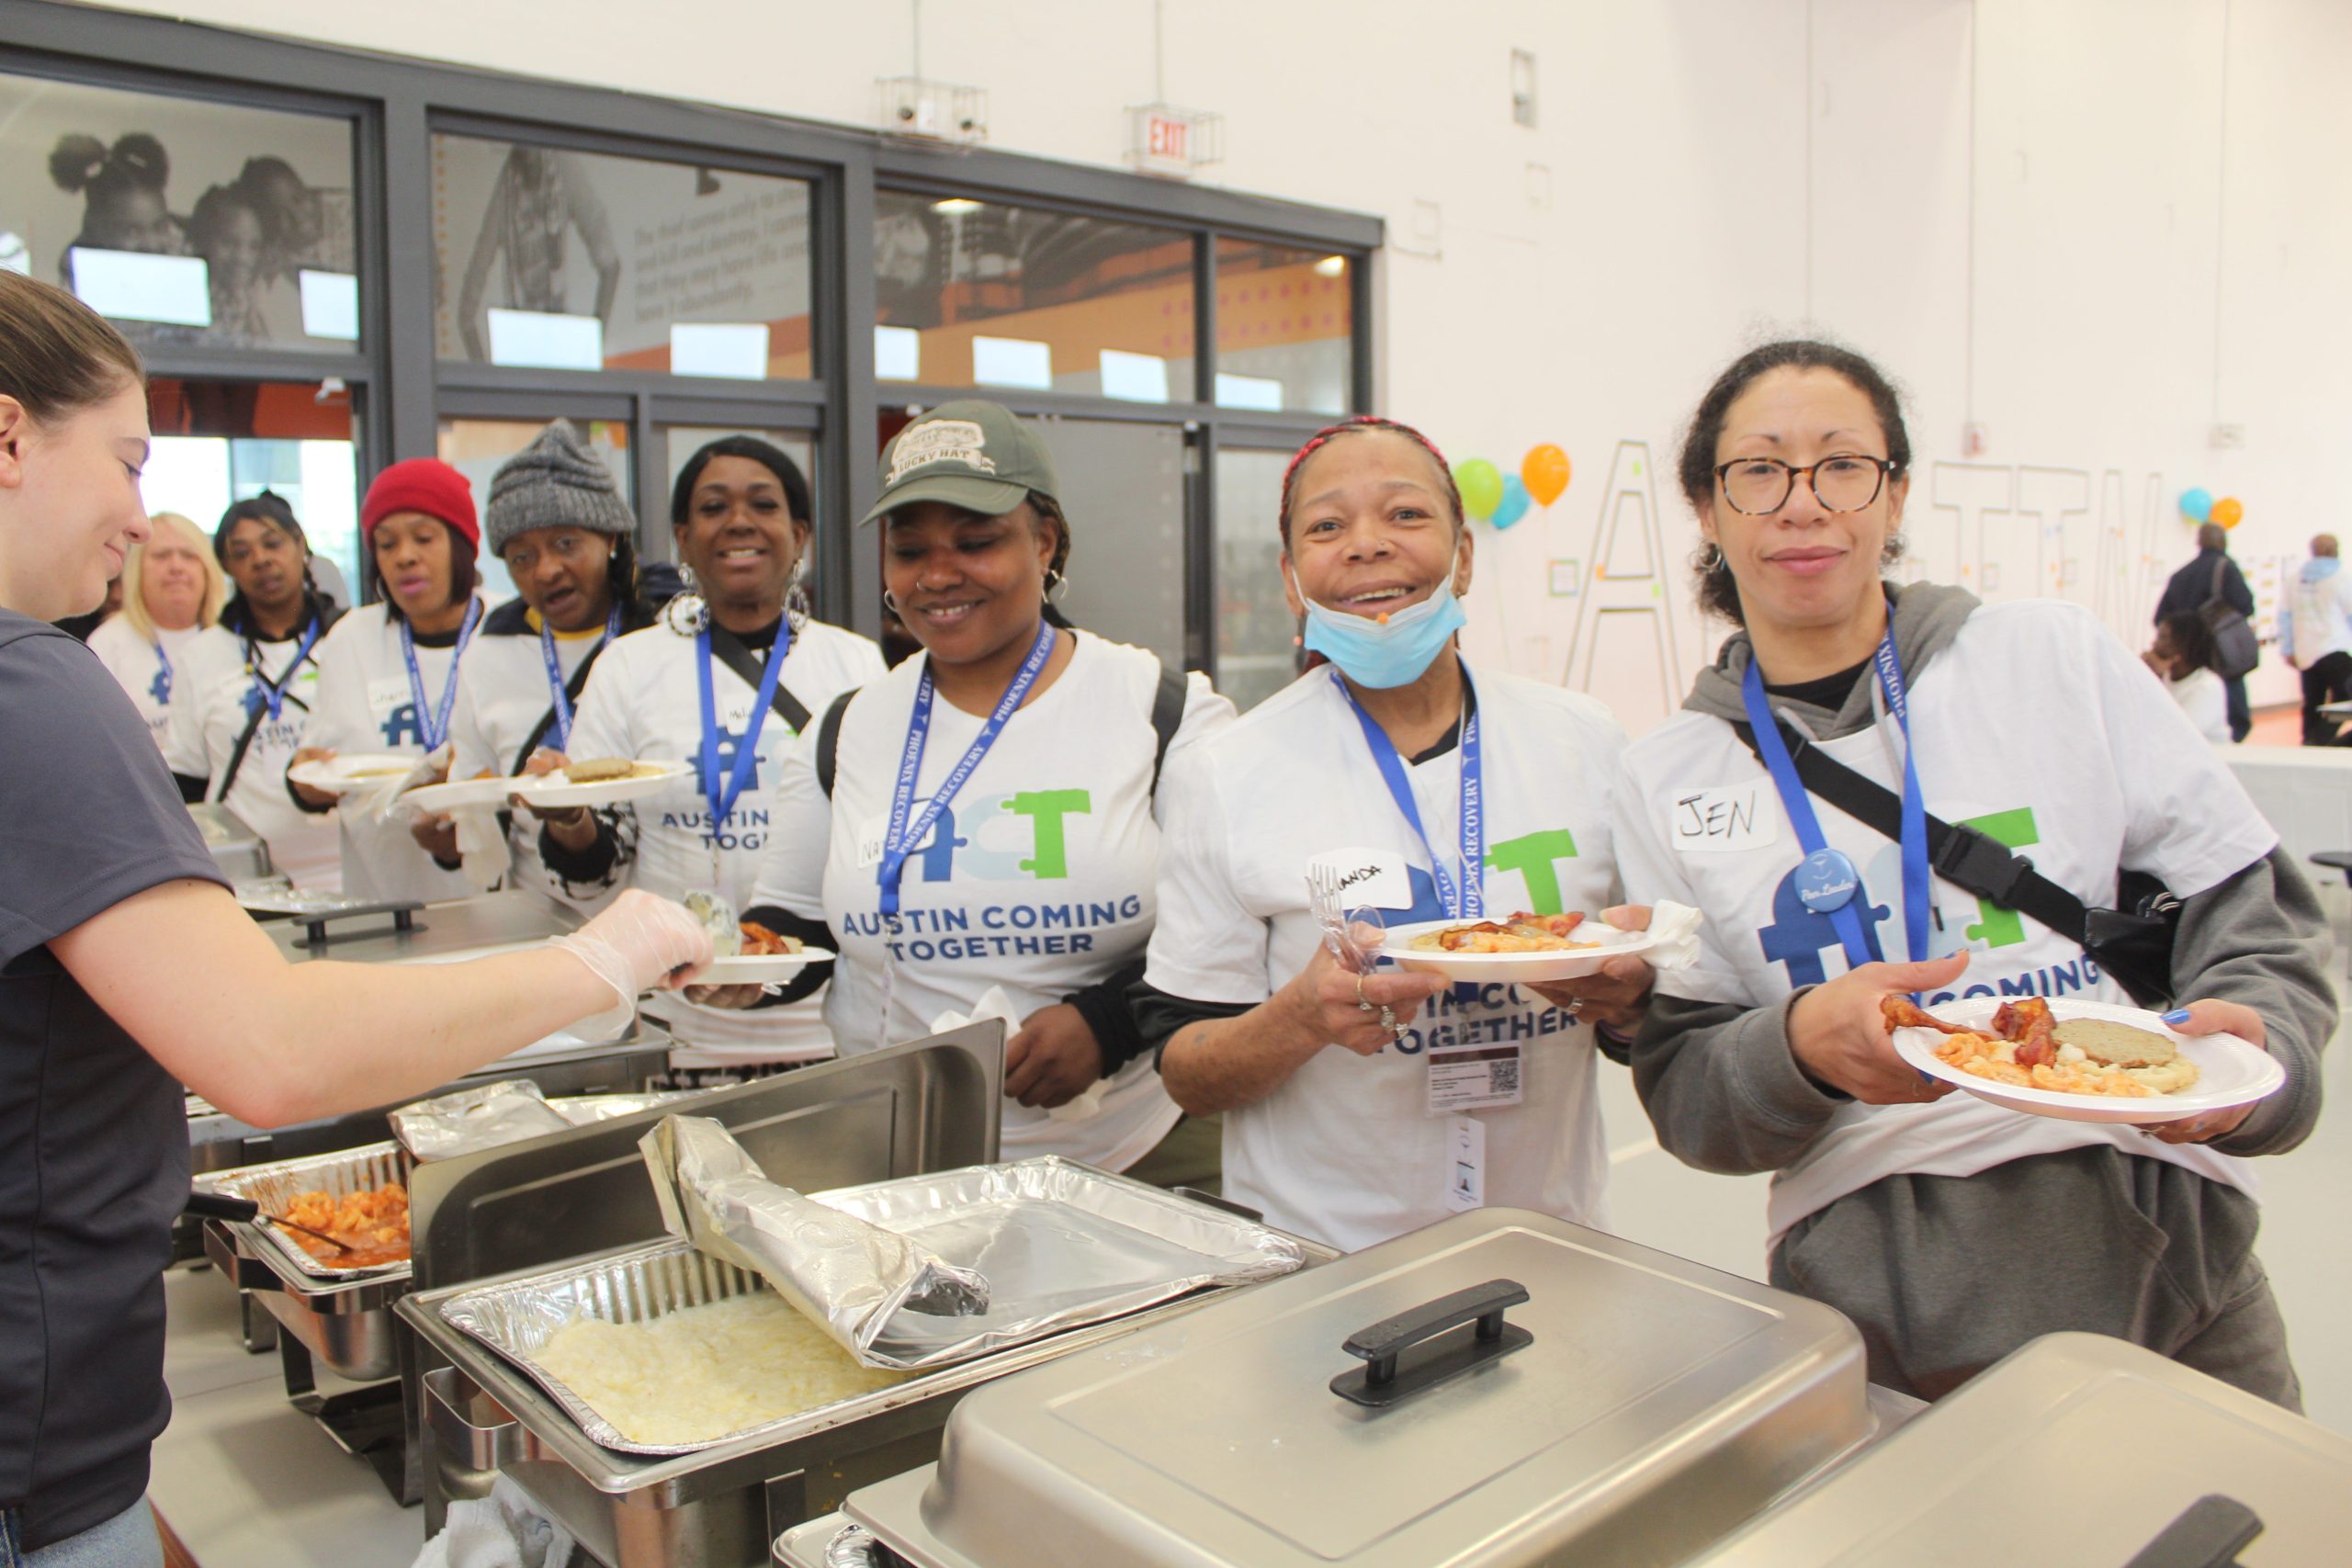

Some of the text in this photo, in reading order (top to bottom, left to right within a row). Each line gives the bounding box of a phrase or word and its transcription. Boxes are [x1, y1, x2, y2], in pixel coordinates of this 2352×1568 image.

[1148, 117, 1188, 162] EXIT
[939, 448, 970, 458] HAT
[994, 671, 1035, 723] PHOENIX
[1878, 644, 1906, 718] PHOENIX
[887, 729, 922, 852] PHOENIX RECOVERY
[898, 744, 986, 854] PHOENIX RECOVERY
[1678, 789, 1756, 839] JEN
[1464, 777, 1480, 919] HOENIX RECOVERY
[843, 895, 1141, 936] AUSTIN COMING
[886, 933, 1093, 962] TOGETHER
[1376, 1006, 1578, 1055] OGETHER
